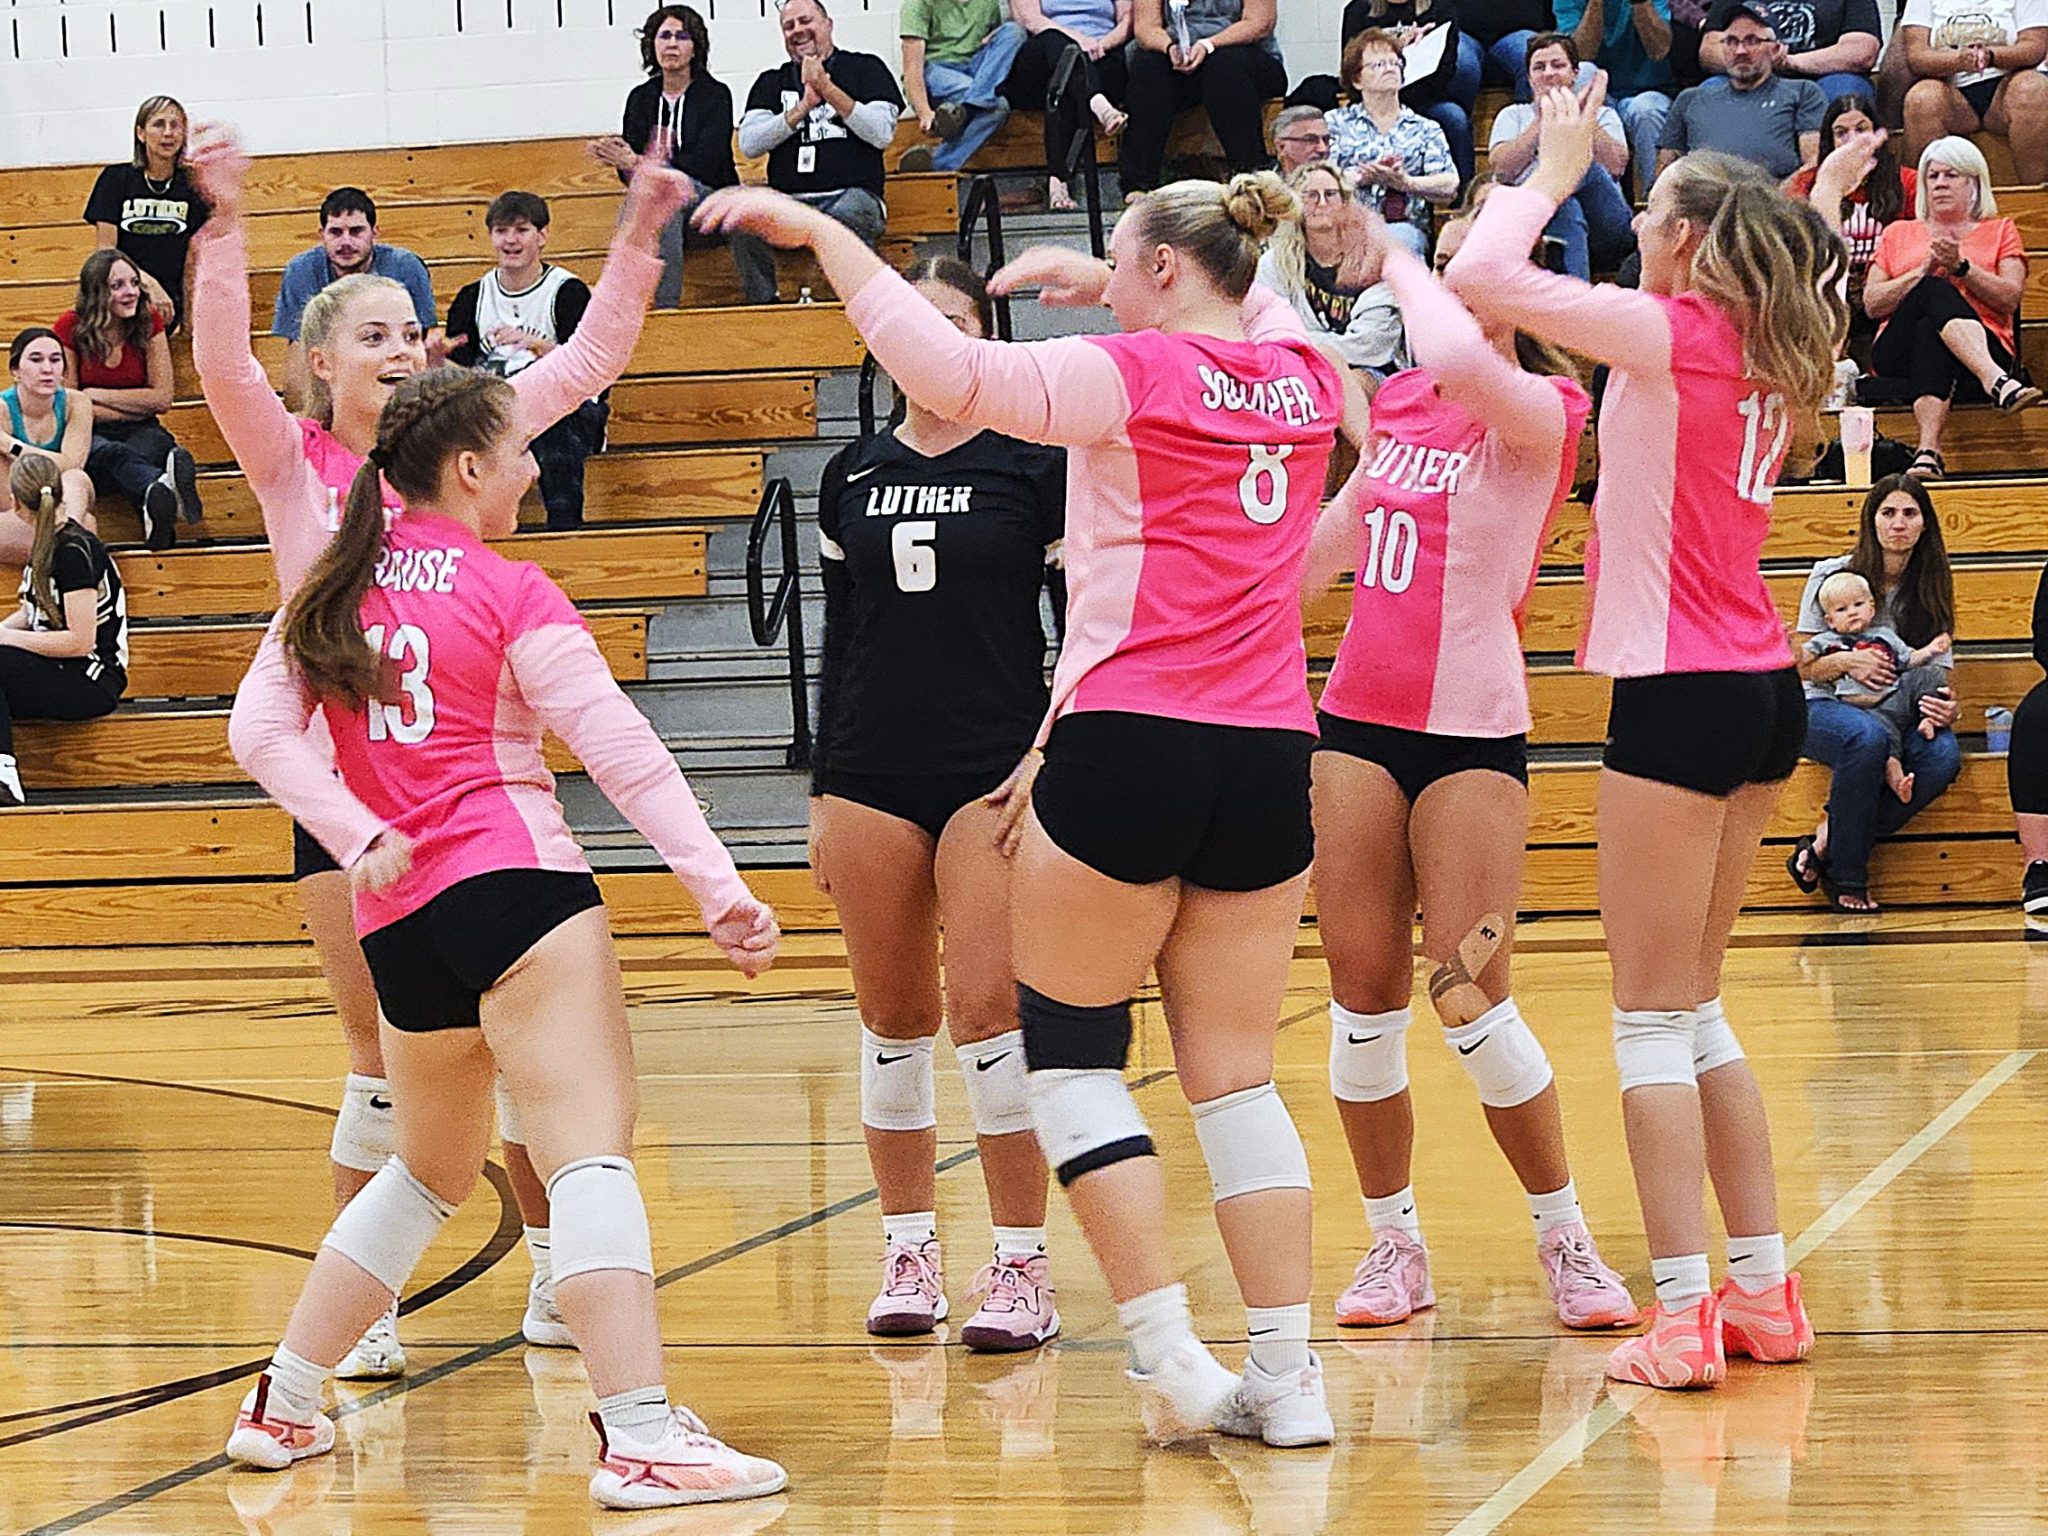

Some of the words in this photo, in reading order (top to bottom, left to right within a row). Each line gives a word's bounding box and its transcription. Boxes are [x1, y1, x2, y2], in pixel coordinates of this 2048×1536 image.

[865, 485, 973, 517] LUTHER
[1238, 443, 1294, 525] 8
[1366, 437, 1468, 495] UTHER
[891, 520, 937, 593] 6
[1362, 505, 1419, 594] 10
